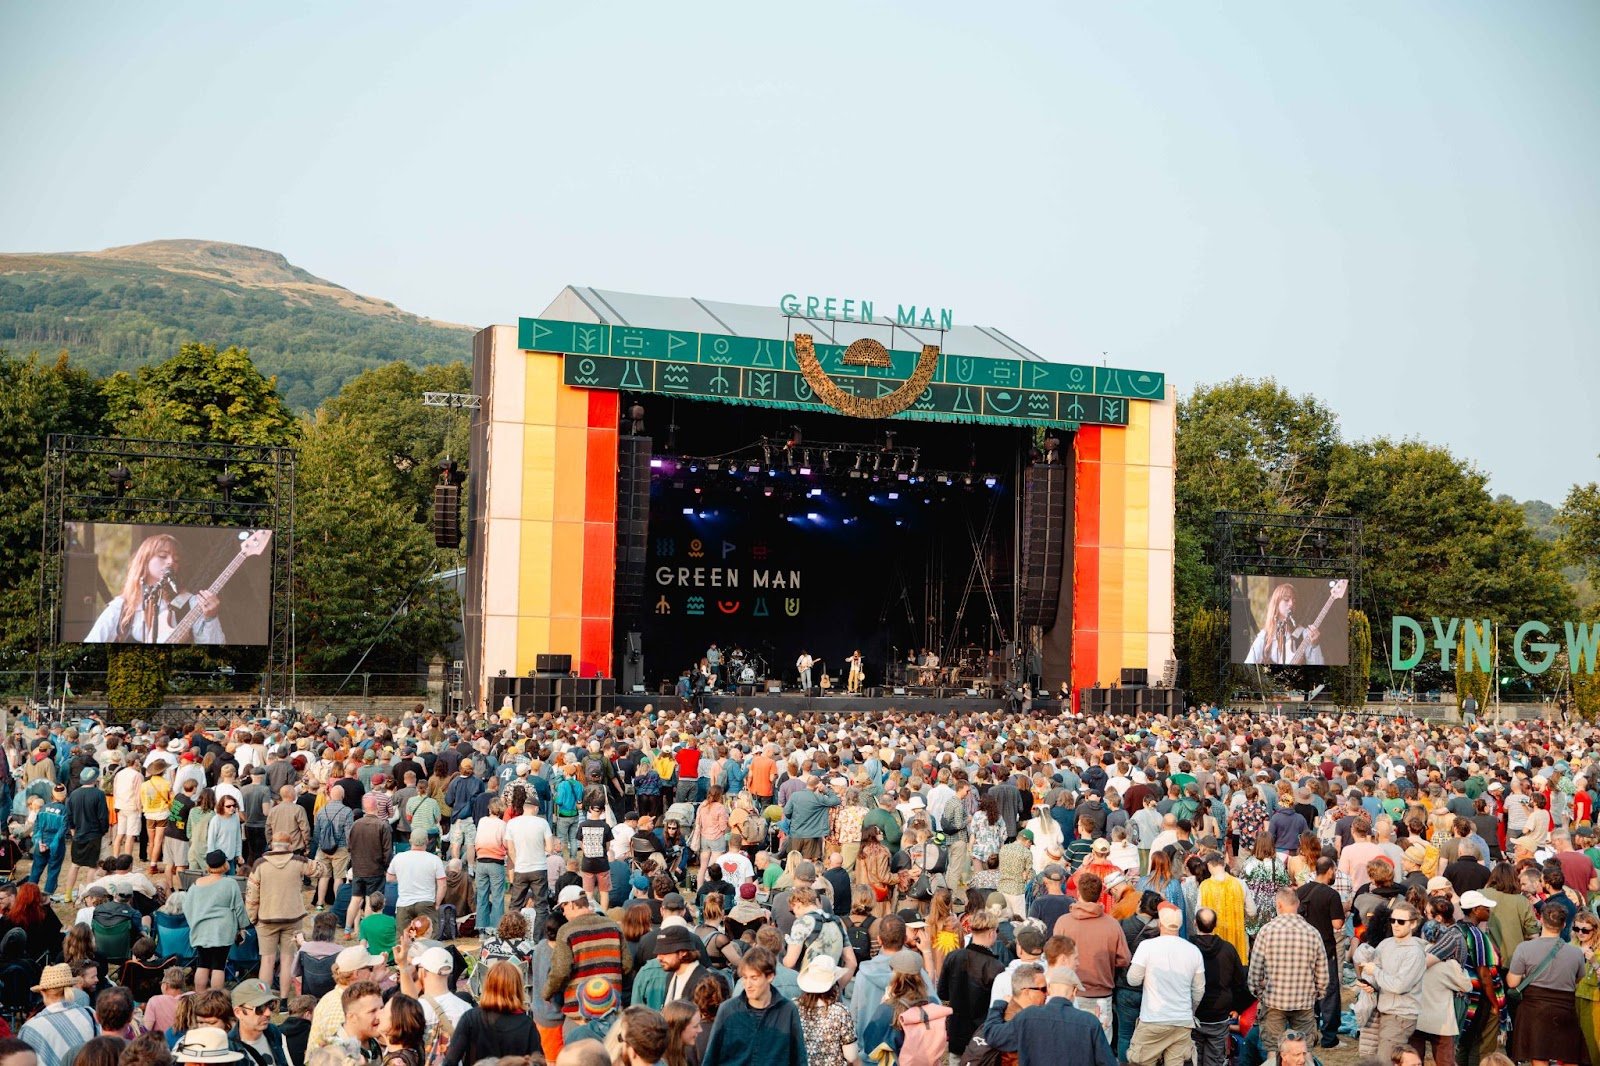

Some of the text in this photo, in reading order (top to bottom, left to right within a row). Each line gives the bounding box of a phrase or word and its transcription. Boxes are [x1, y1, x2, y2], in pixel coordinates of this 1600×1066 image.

[780, 294, 953, 330] GREEN MAN
[655, 566, 801, 589] GREEN MAN
[1391, 615, 1600, 675] DYN GW
